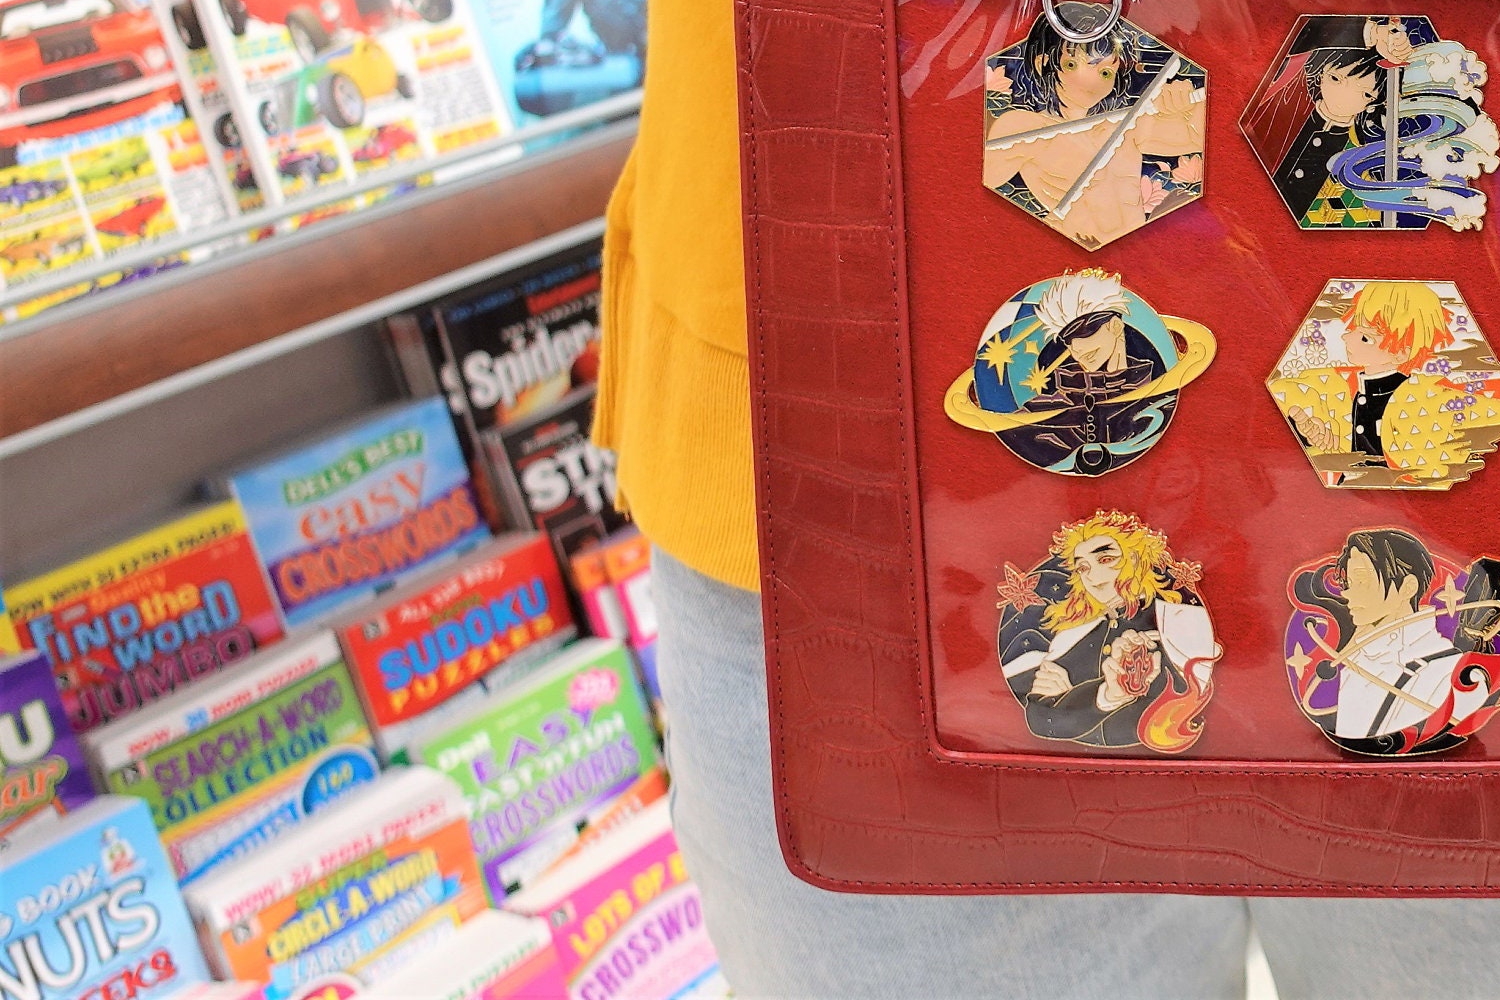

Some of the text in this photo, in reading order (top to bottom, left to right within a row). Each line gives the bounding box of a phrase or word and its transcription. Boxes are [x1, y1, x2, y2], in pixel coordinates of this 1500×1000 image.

[280, 487, 477, 602] CROSSWORDS
[73, 624, 256, 724] JUMBO
[112, 578, 241, 672] WORD
[379, 576, 549, 691] SUDOKU
[152, 724, 328, 836] OLLECTION
[468, 731, 640, 856] CROSSWORDS
[580, 895, 700, 1000] CROSSWO
